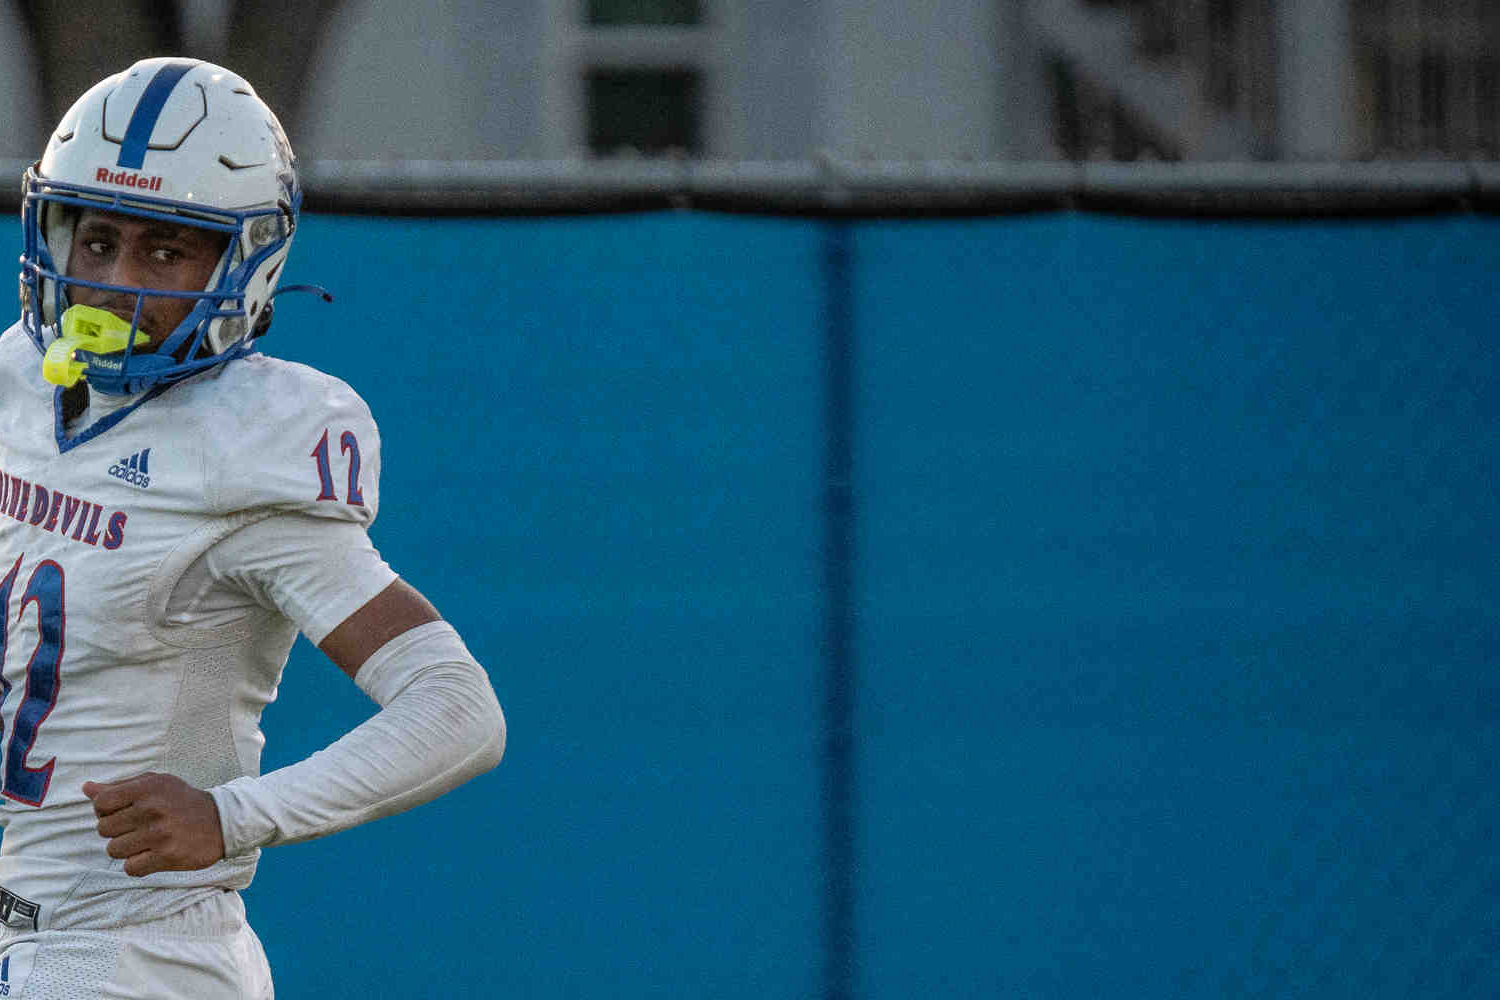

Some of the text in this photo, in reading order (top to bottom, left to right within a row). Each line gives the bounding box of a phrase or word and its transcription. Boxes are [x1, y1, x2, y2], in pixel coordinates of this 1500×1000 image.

[96, 168, 162, 191] Riddell
[108, 464, 150, 488] adidas
[310, 427, 365, 507] 12
